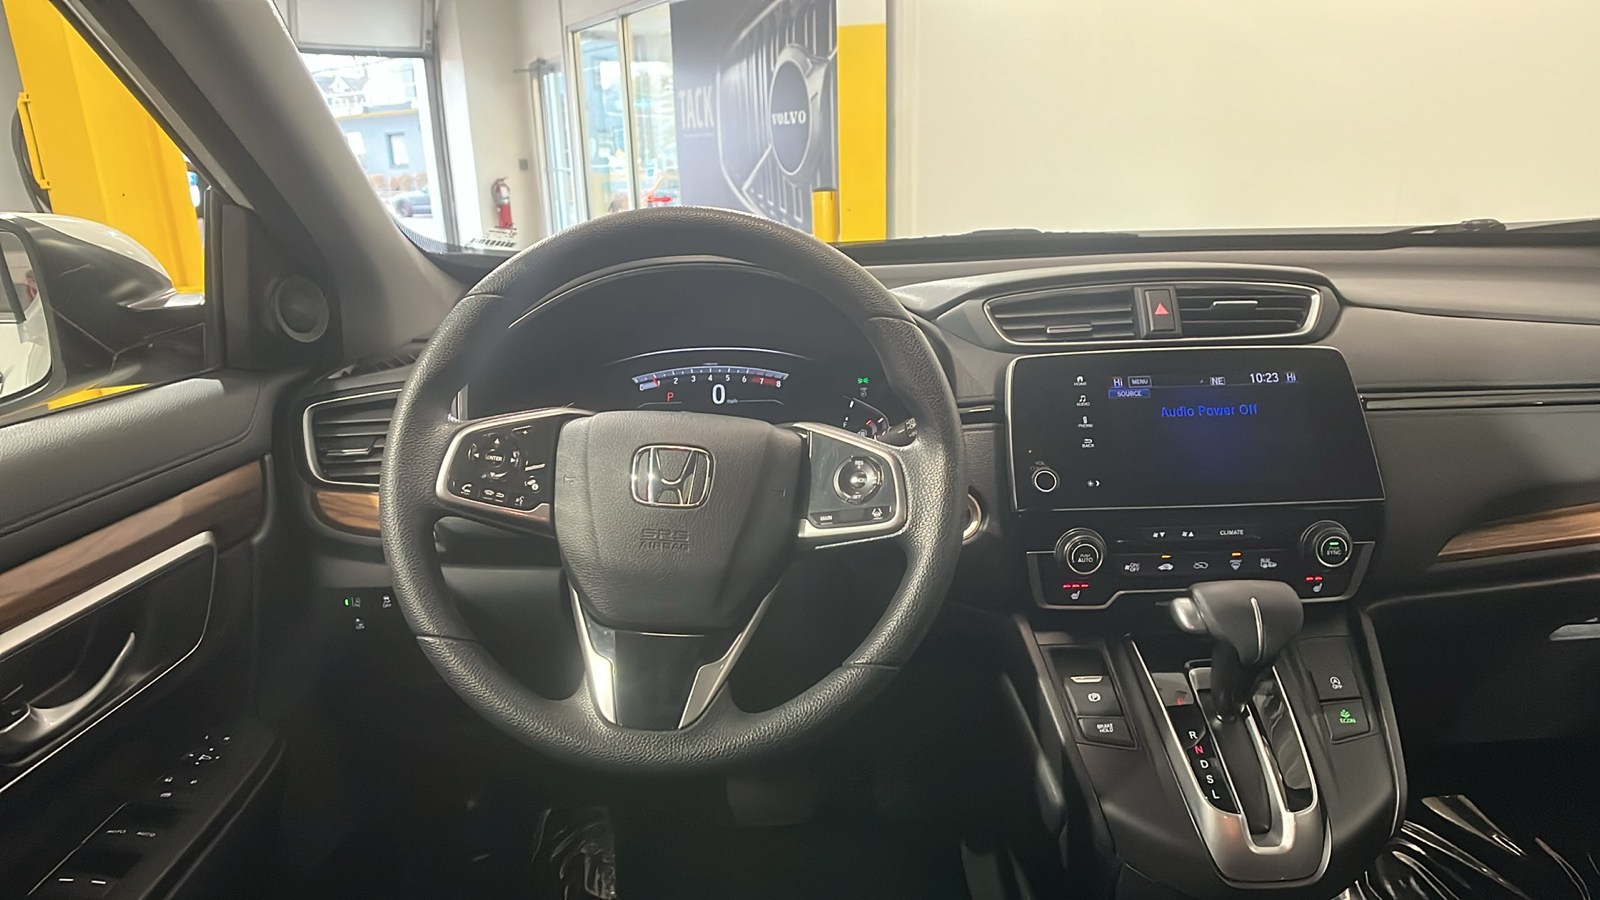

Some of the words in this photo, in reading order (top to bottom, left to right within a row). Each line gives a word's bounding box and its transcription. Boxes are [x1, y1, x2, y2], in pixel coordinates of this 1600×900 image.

[678, 84, 714, 129] TACK
[772, 110, 806, 125] VOLVO
[673, 377, 678, 385] 2
[726, 374, 730, 382] 5
[776, 380, 781, 388] 8
[1211, 377, 1224, 385] NE
[1250, 372, 1279, 383] 10:23
[668, 392, 674, 402] P
[712, 384, 726, 404] 0
[1161, 406, 1195, 418] Audio
[1198, 405, 1235, 417] Power
[1239, 403, 1258, 415] Off
[640, 529, 690, 542] SRS
[1188, 730, 1198, 740] R
[1194, 746, 1204, 754] N
[1200, 760, 1208, 768] D
[1206, 774, 1214, 784] S
[1212, 789, 1220, 798] L
